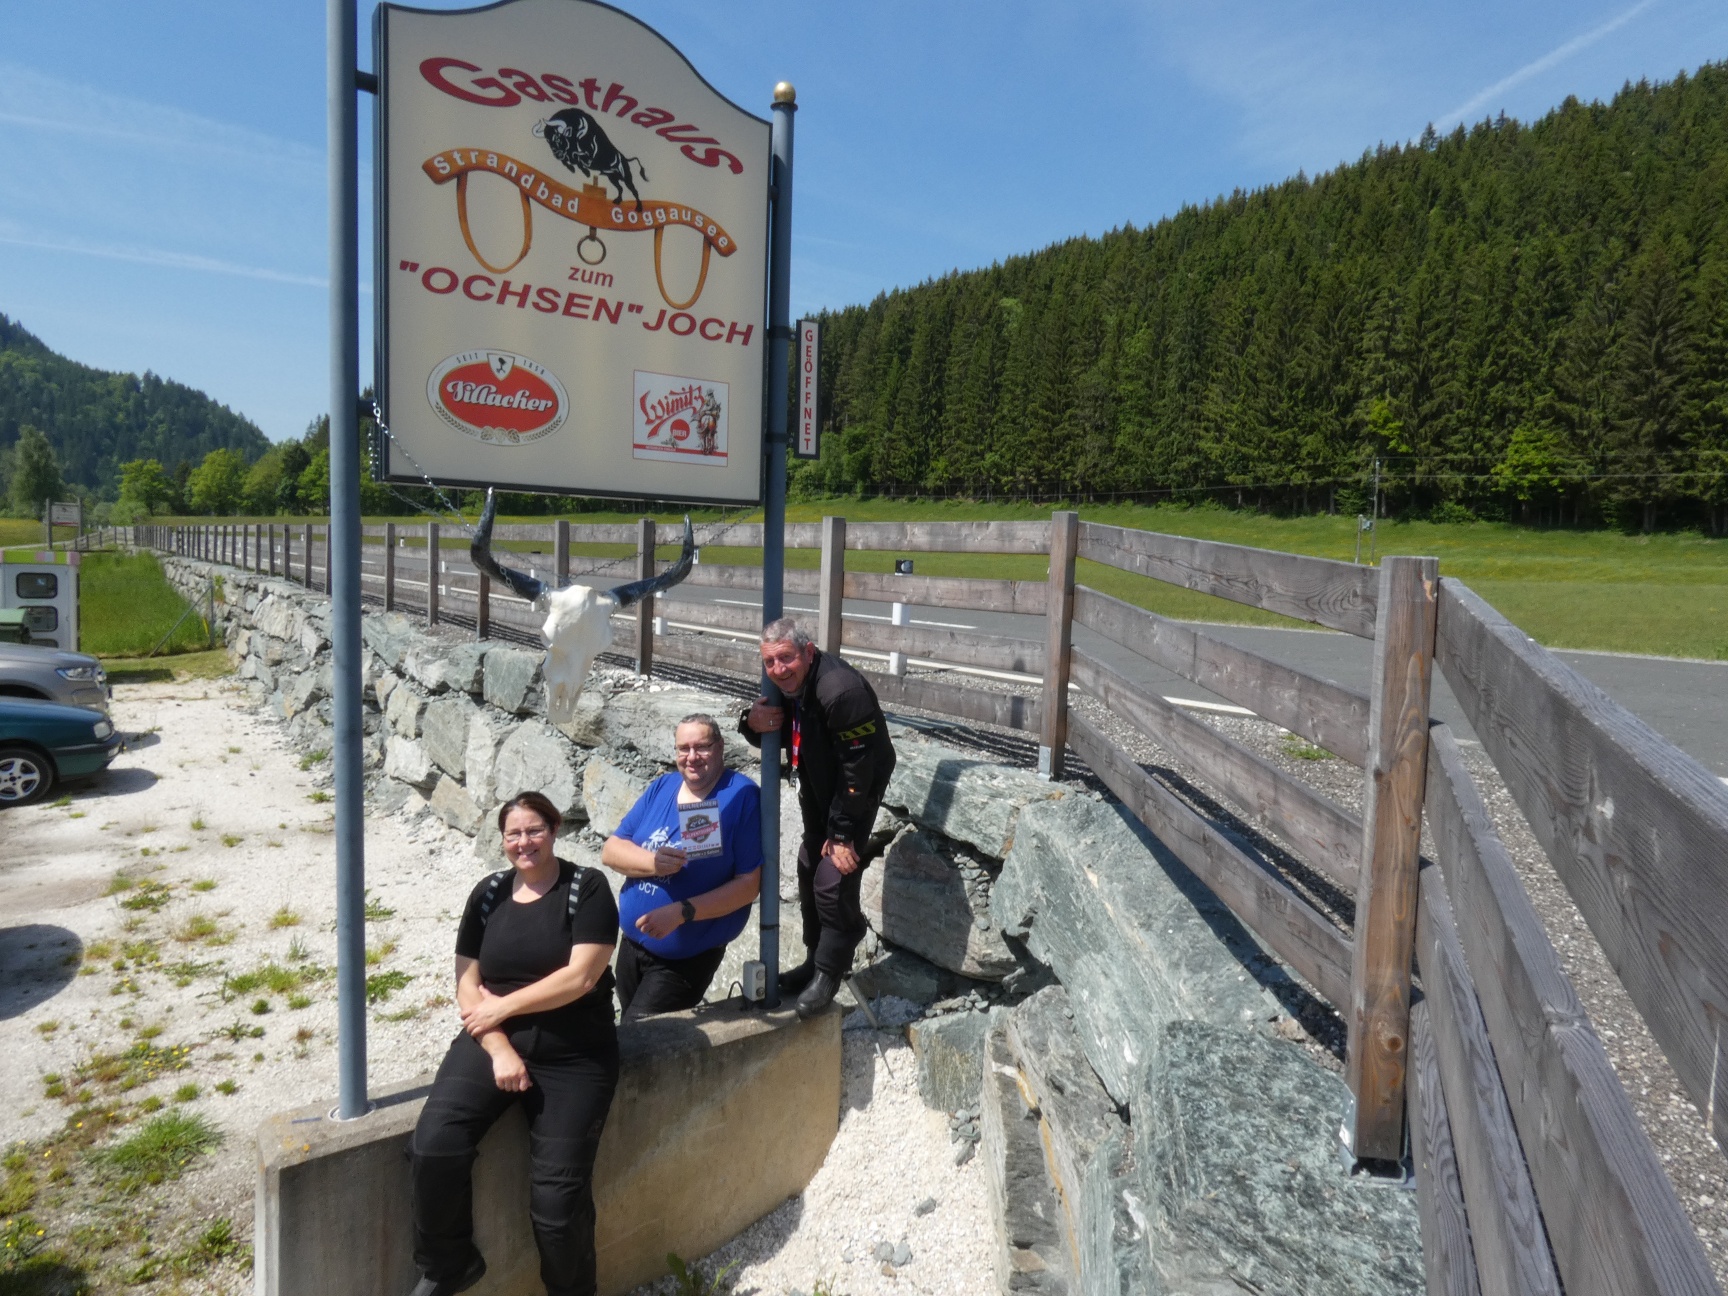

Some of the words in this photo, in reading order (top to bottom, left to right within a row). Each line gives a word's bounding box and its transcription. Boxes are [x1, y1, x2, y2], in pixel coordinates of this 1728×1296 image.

[419, 57, 744, 175] Gasthaus
[433, 150, 579, 215] Strandbad
[611, 206, 728, 248] Goggausee
[568, 266, 614, 287] zum
[446, 380, 553, 412] Villacher
[804, 329, 813, 451] GEÖFFNET
[673, 429, 687, 437] BIER
